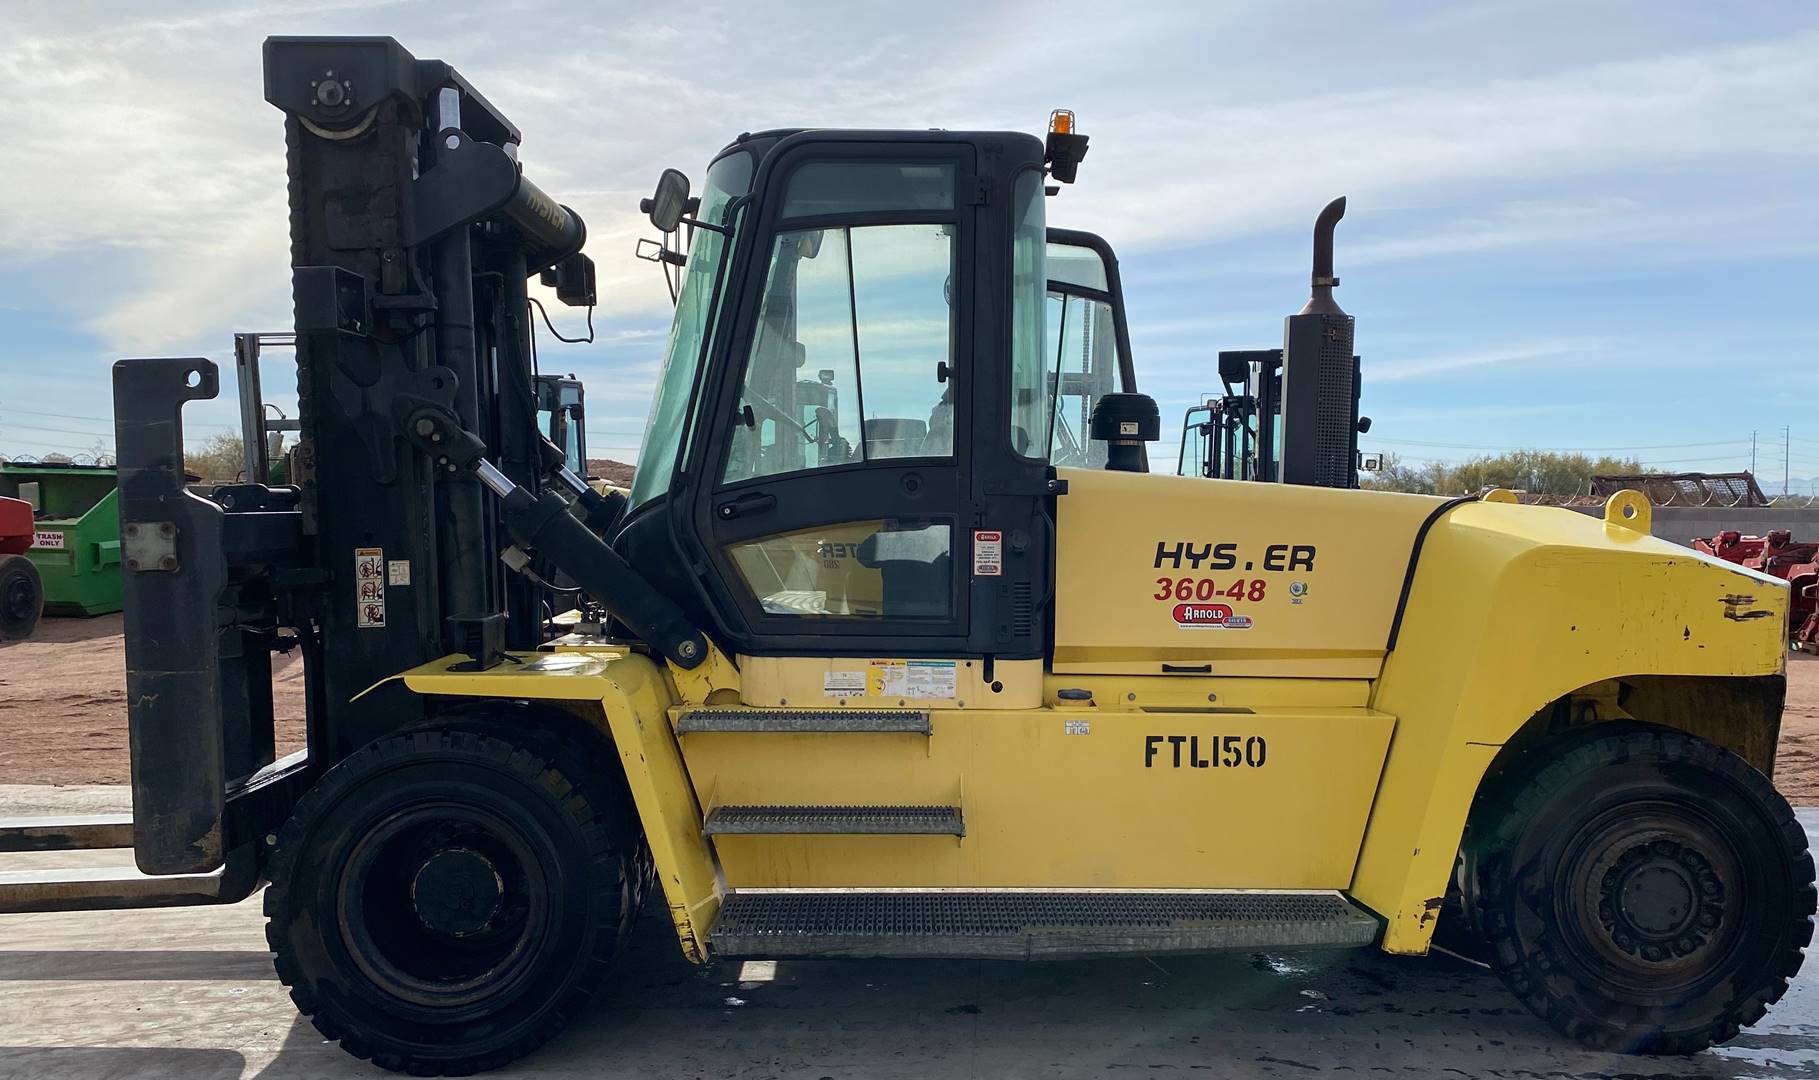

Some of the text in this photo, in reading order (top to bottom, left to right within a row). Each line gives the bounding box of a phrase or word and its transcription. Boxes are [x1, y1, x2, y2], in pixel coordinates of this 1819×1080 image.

[1154, 541, 1316, 572] HYSER
[1153, 577, 1267, 602] 360-48
[1184, 606, 1224, 620] ARNOLD
